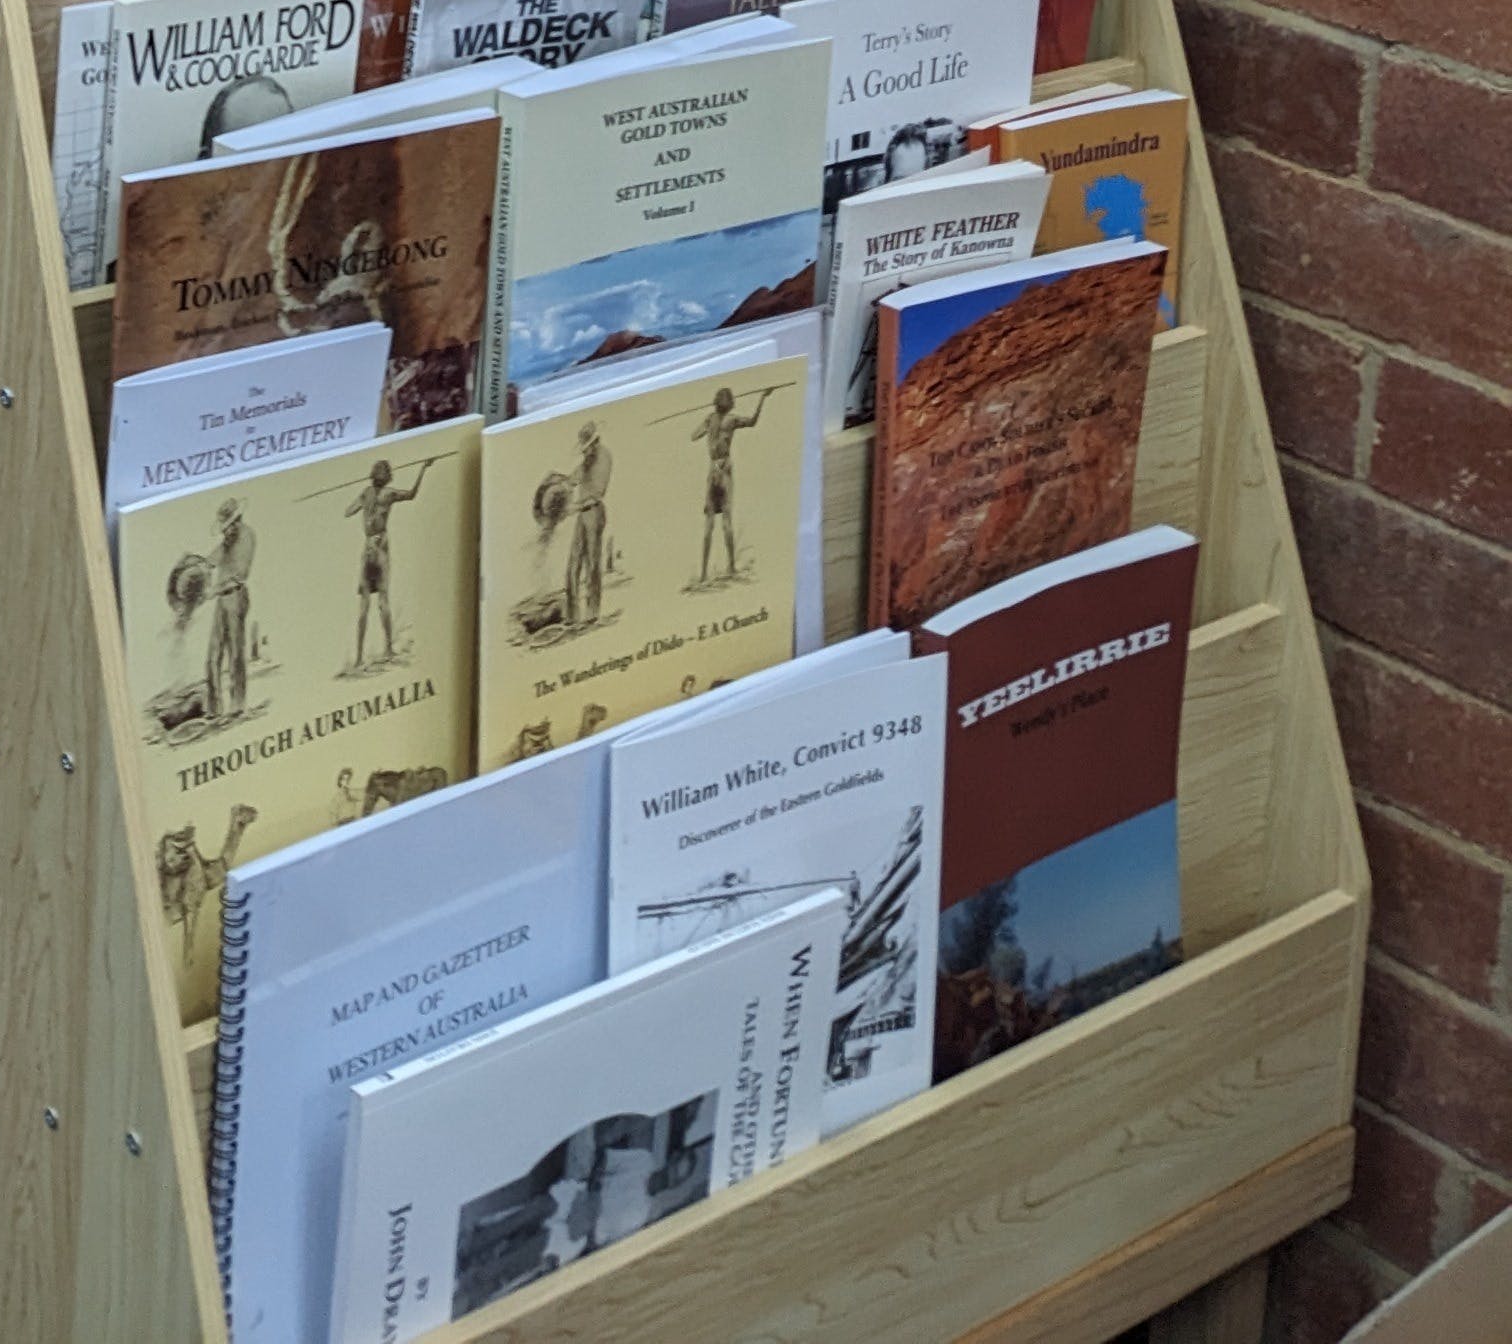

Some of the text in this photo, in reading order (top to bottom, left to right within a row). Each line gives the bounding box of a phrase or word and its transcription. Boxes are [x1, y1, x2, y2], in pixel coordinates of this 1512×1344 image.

[127, 11, 265, 86] WILLIAM
[453, 11, 616, 58] WALDECK
[915, 22, 953, 43] Story
[166, 41, 320, 91] & COOLGARDIE
[838, 52, 968, 104] A Good Life
[603, 88, 749, 127] WEST AUSTRALIAN
[621, 113, 728, 144] GOLD TOWNS
[654, 148, 690, 166] AND
[1040, 132, 1160, 172] Yundamindra
[615, 168, 726, 203] SETTLEMENTS
[864, 235, 1014, 277] The Story of Kanowna
[866, 212, 1020, 256] WHITE FEATHER
[200, 392, 307, 430] Tin Memorials
[142, 416, 350, 488] MENZIES CEMETERY
[957, 622, 1170, 728] YEELIRRIE
[175, 678, 436, 793] THROUGH AURUMALIA
[642, 716, 923, 820] William White, Convict 9348
[330, 924, 532, 1026] MAP AND GAZETTEER
[418, 990, 445, 1015] OF
[326, 1026, 420, 1085] WESTERN
[422, 982, 529, 1043] AUSTRALIA
